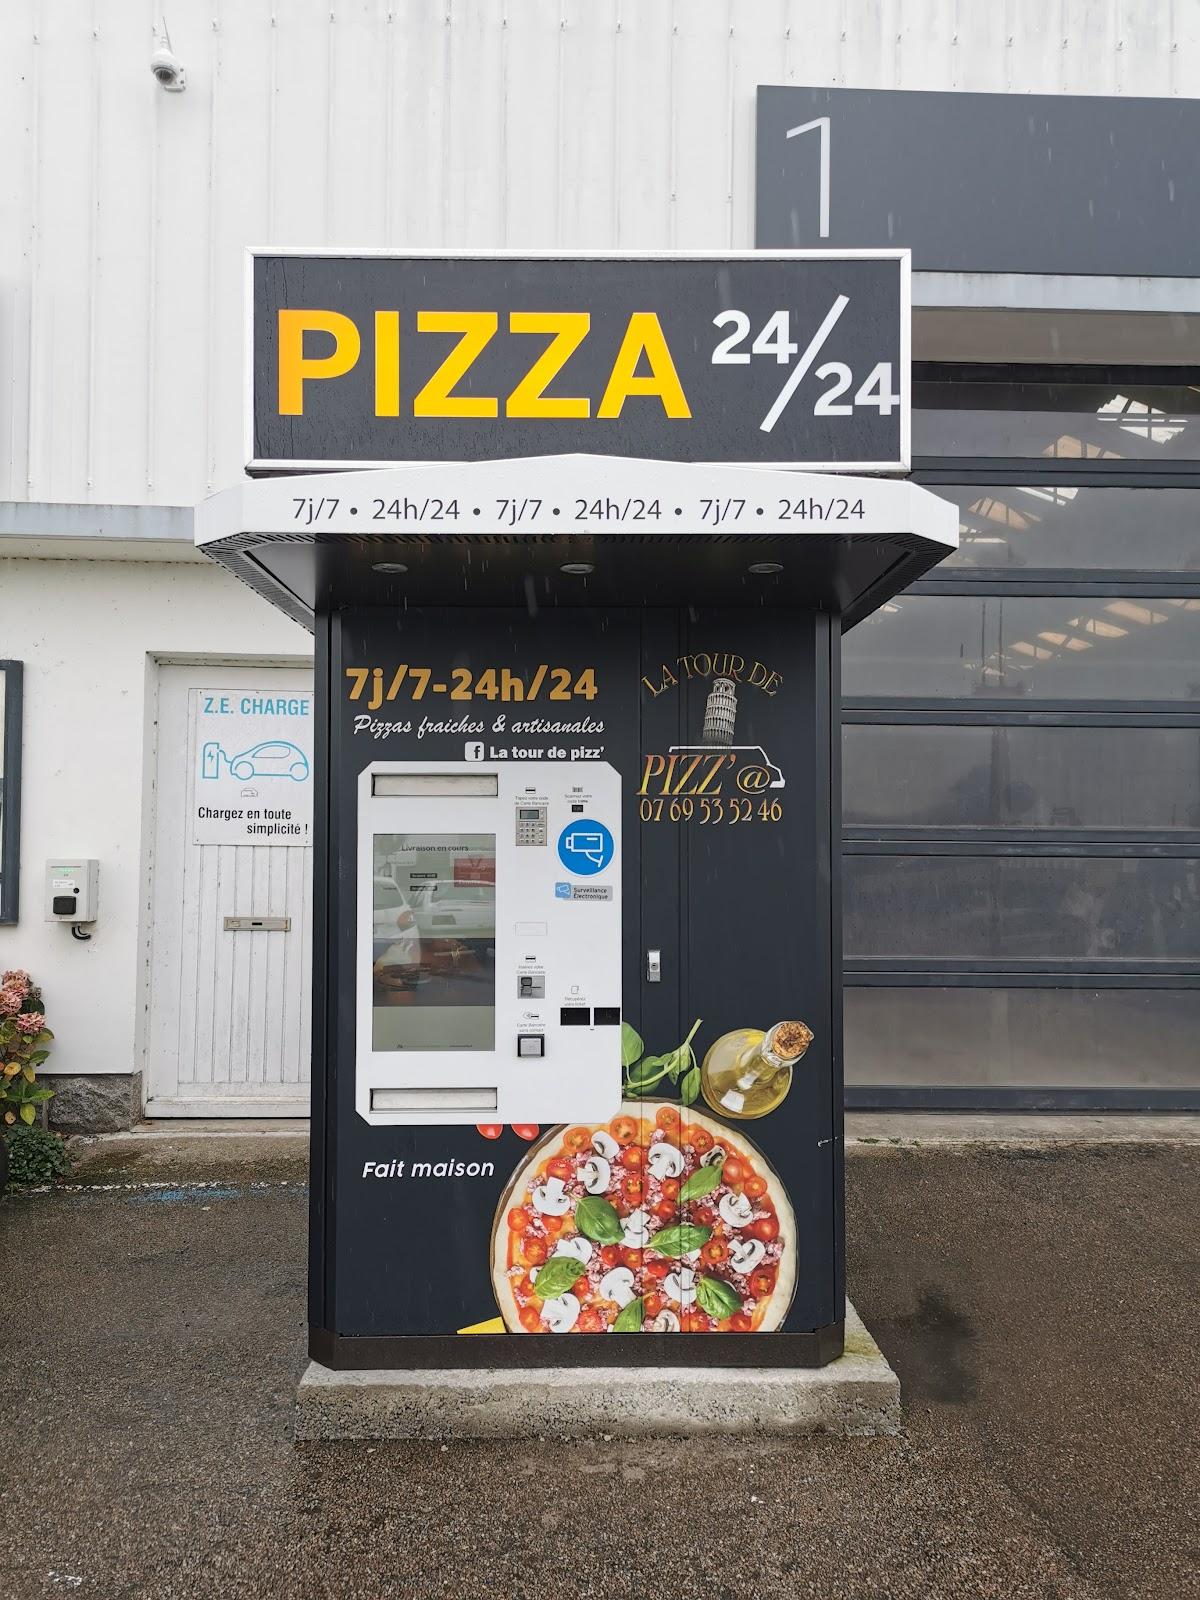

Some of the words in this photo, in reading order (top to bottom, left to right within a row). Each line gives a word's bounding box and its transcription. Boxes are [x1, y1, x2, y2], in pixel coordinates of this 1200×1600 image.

[786, 116, 831, 238] 1
[278, 309, 692, 419] PIZZA
[292, 497, 340, 525] 7j/7
[372, 497, 460, 520] 24h/24
[495, 497, 543, 526] 7j/7
[574, 497, 662, 520] 24h/24
[699, 498, 746, 526] 7j/7
[778, 497, 866, 520] 24h/24
[345, 664, 598, 710] 7j/7-24h/24
[641, 664, 679, 698] LA
[676, 652, 744, 683] TOUR
[748, 661, 784, 697] DE
[203, 697, 234, 714] Z.E.
[240, 698, 310, 716] CHARGE
[353, 714, 412, 739] Pizzas
[417, 715, 485, 739] fraiches
[491, 714, 506, 733] &
[511, 716, 605, 733] artisanales
[489, 746, 508, 759] La
[511, 746, 544, 759] tour
[547, 746, 567, 759] de
[198, 807, 243, 821] Chargez
[247, 811, 260, 820] en
[264, 808, 291, 820] toute
[639, 798, 665, 822] 07
[669, 798, 694, 822] 69
[699, 798, 724, 825] 53
[728, 798, 753, 825] 52
[757, 797, 783, 822] 46
[246, 823, 301, 836] simplicité
[362, 1159, 405, 1178] Fait
[410, 1158, 495, 1177] maison
